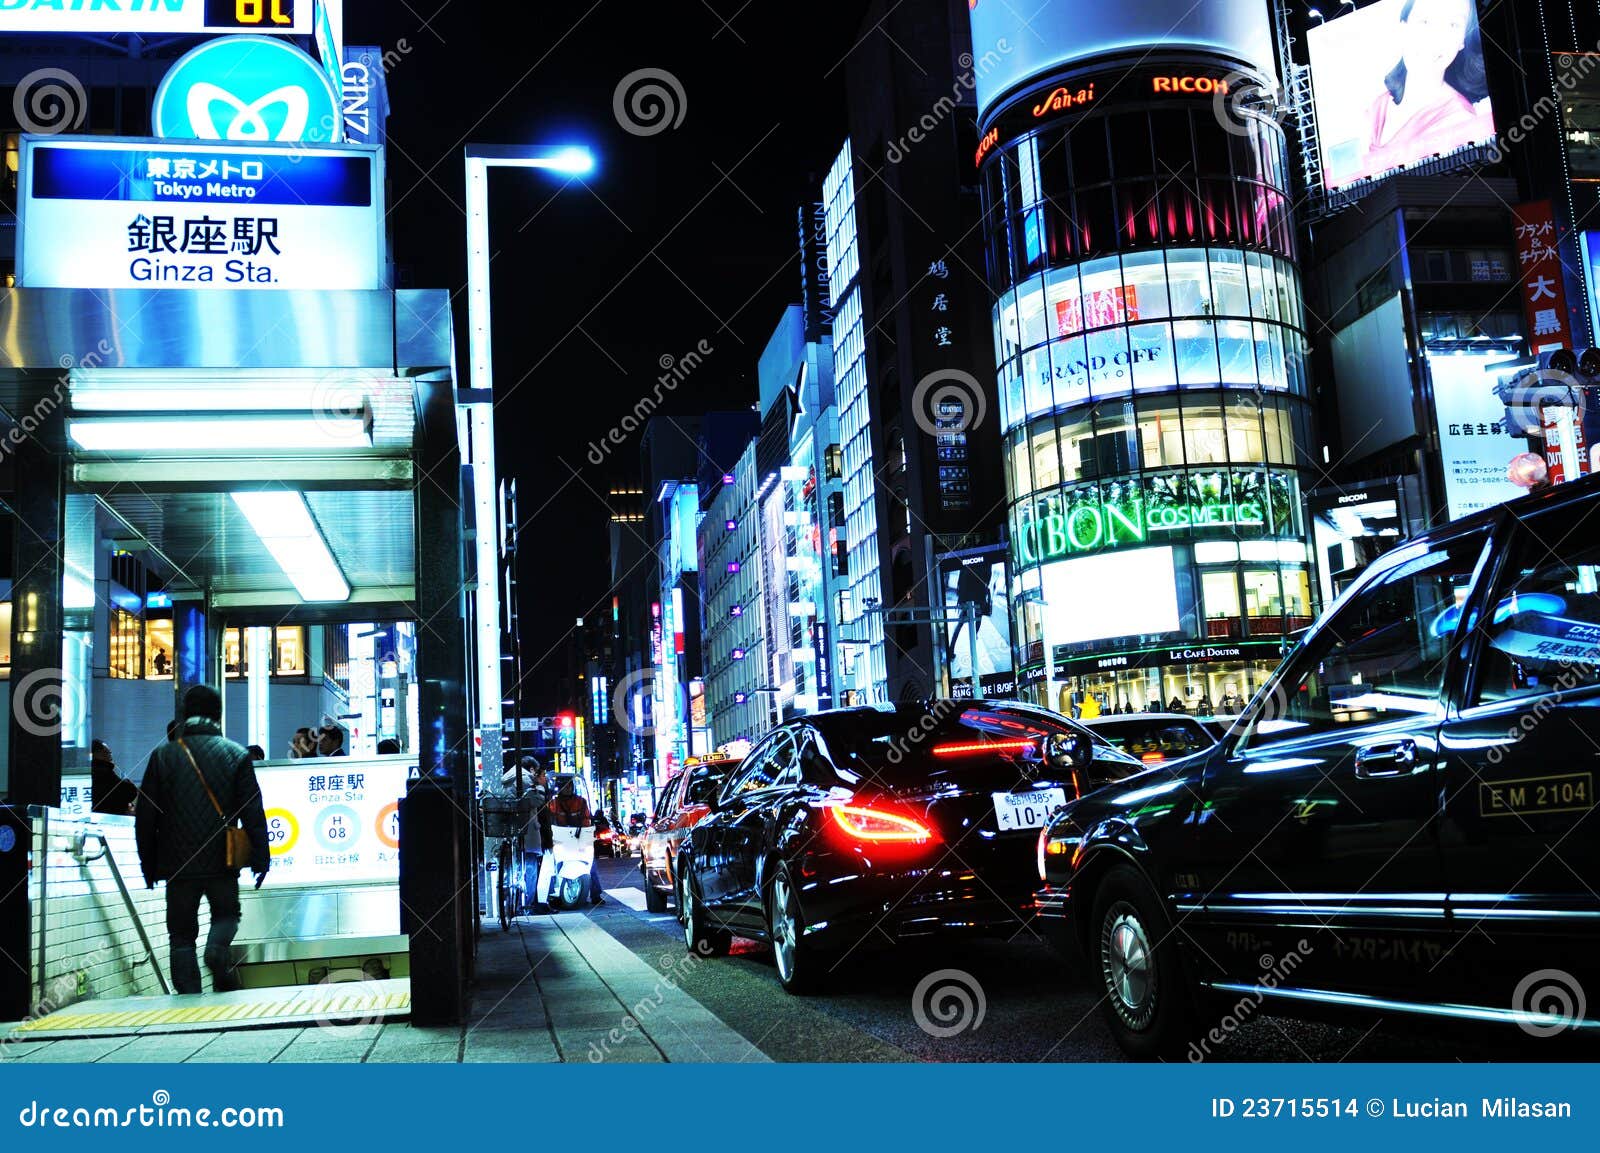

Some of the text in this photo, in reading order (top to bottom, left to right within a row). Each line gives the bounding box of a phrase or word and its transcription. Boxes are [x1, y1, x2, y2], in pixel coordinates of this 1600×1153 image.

[1153, 76, 1228, 95] RICOH
[146, 157, 263, 181] 東京メトロ
[153, 181, 256, 199] Tokyo Metro
[127, 213, 281, 256] 銀座駅
[1515, 220, 1553, 240] ブランド
[1530, 238, 1543, 249] &
[1519, 245, 1557, 265] チケット
[129, 257, 279, 283] Ginza Sta.
[1527, 275, 1563, 353] 大黒
[1041, 346, 1162, 386] BRAND OFF
[1449, 422, 1510, 436] 広告主募
[1338, 492, 1368, 504] RICOH
[1147, 503, 1264, 528] COSMETICS
[1206, 648, 1240, 658] DOUTOR
[952, 688, 972, 698] RING
[308, 774, 364, 791] 銀座駅
[309, 793, 341, 803] Ginza
[1536, 781, 1586, 805] 2104
[270, 818, 281, 829] G
[332, 816, 342, 825] H
[328, 827, 346, 839] 08
